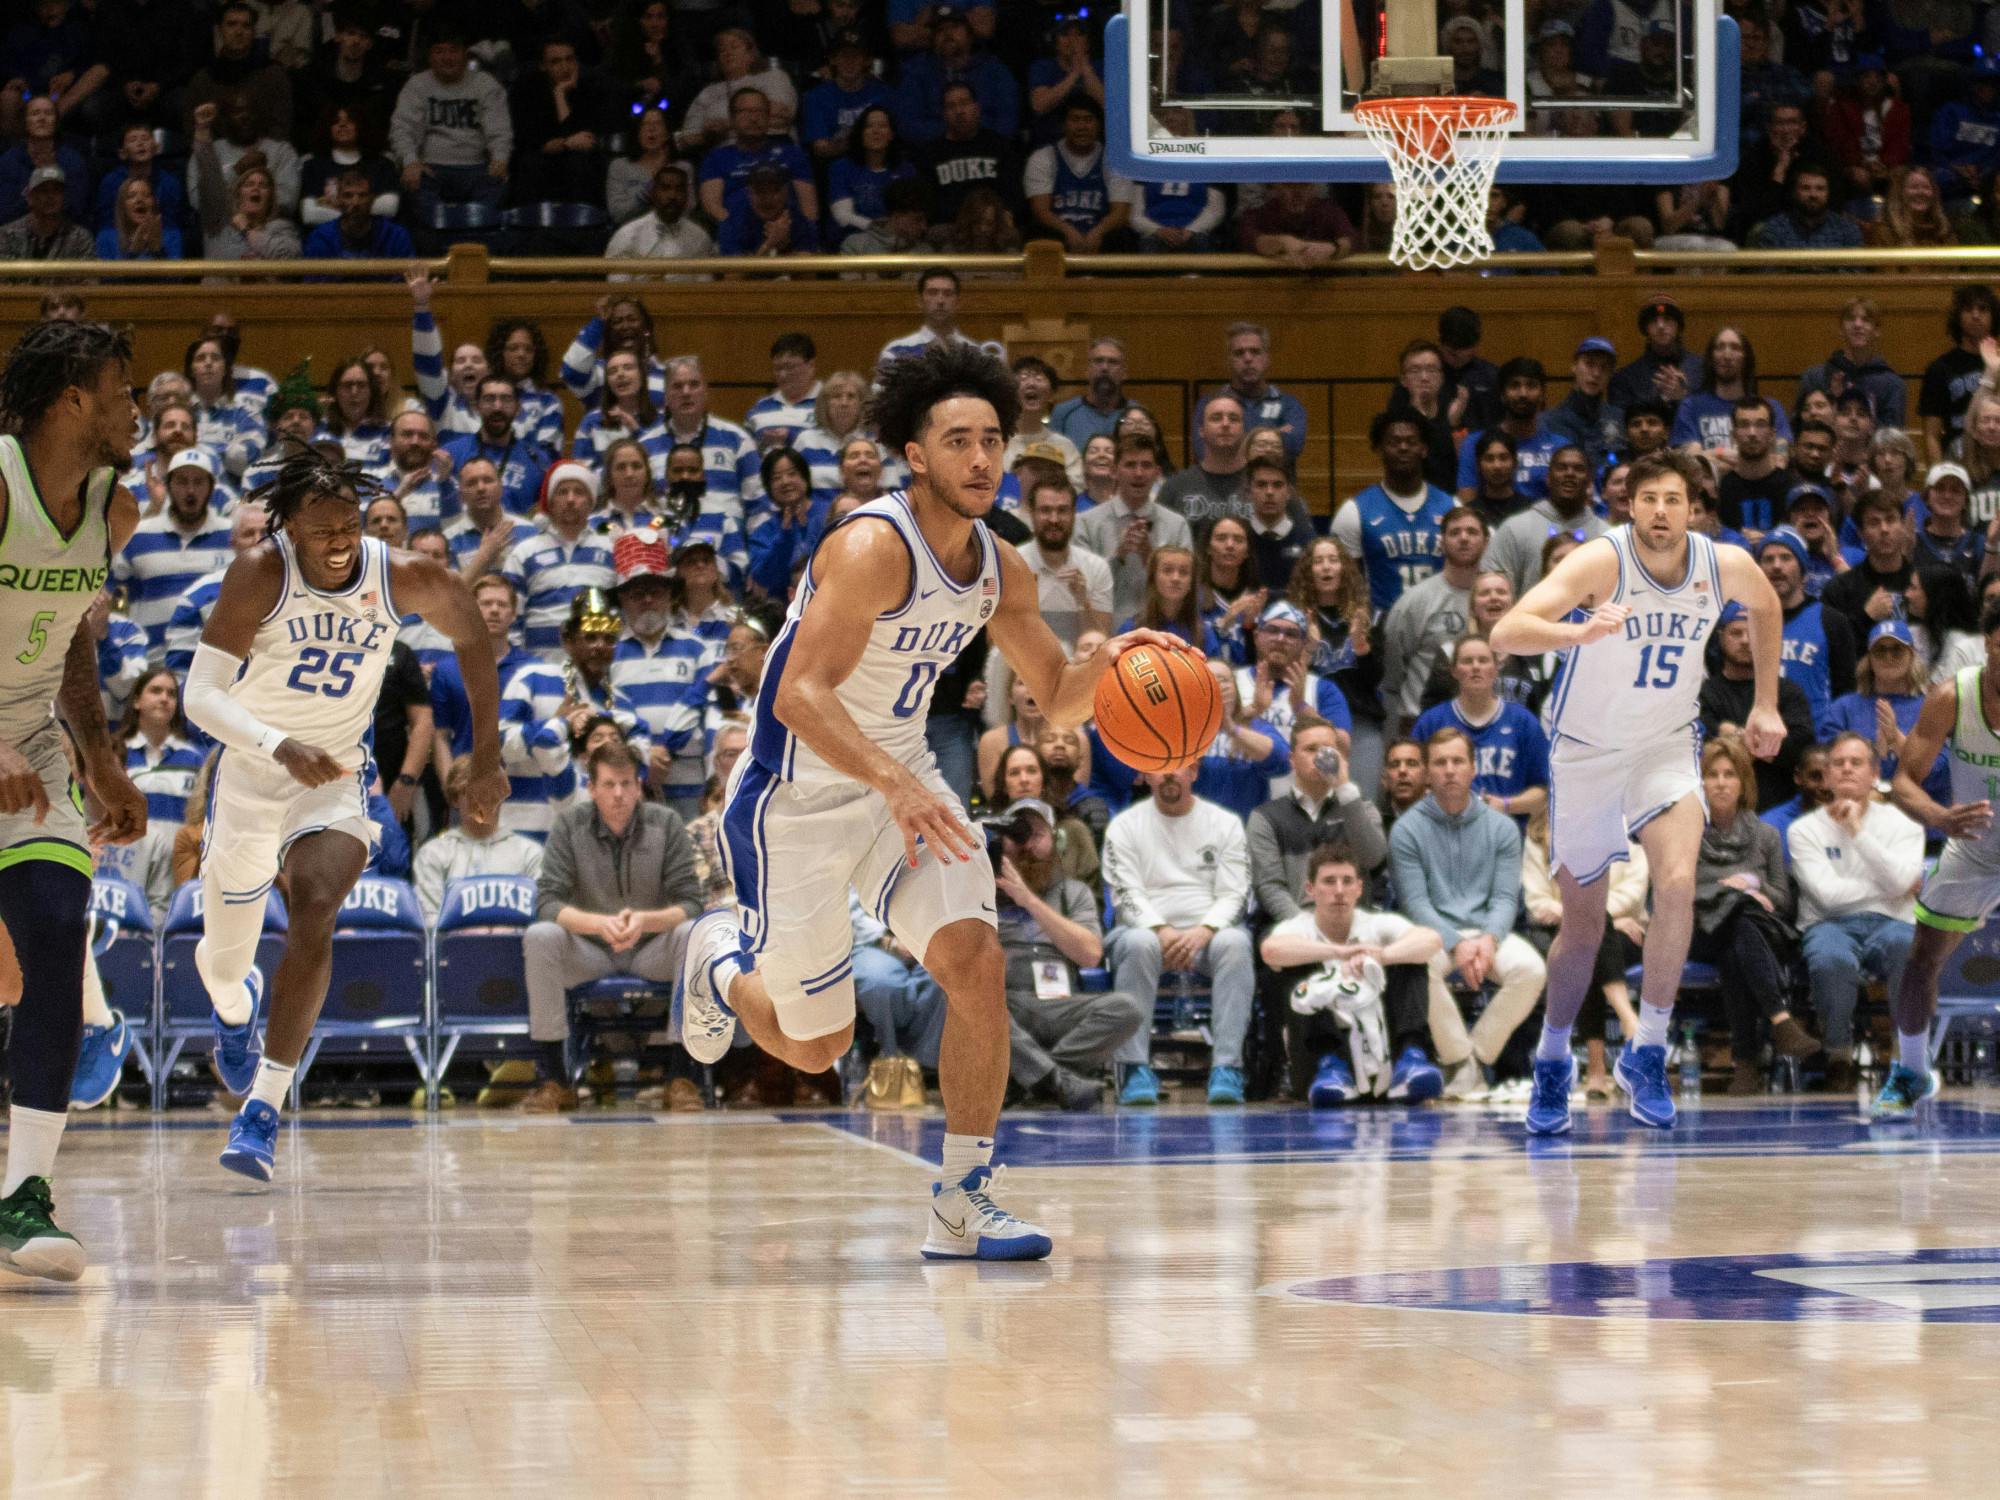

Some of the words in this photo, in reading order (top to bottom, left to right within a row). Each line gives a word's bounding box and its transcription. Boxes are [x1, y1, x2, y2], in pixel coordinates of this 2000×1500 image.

[1148, 142, 1206, 155] SPALDING
[936, 158, 998, 185] DUKE
[1182, 494, 1256, 521] Duke
[0, 564, 107, 592] QUEENS
[16, 611, 57, 665] 5
[286, 612, 388, 651] DUKE
[890, 620, 975, 655] DUK
[1625, 612, 1710, 641] DUKE
[1633, 644, 1686, 688] 15
[1782, 639, 1820, 666] KE
[286, 646, 365, 698] 25
[892, 661, 938, 718] 0
[1475, 746, 1517, 779] KE
[1955, 748, 2000, 768] QUE
[90, 883, 128, 919] KE
[338, 880, 398, 917] UKE
[461, 880, 533, 917] DUKE
